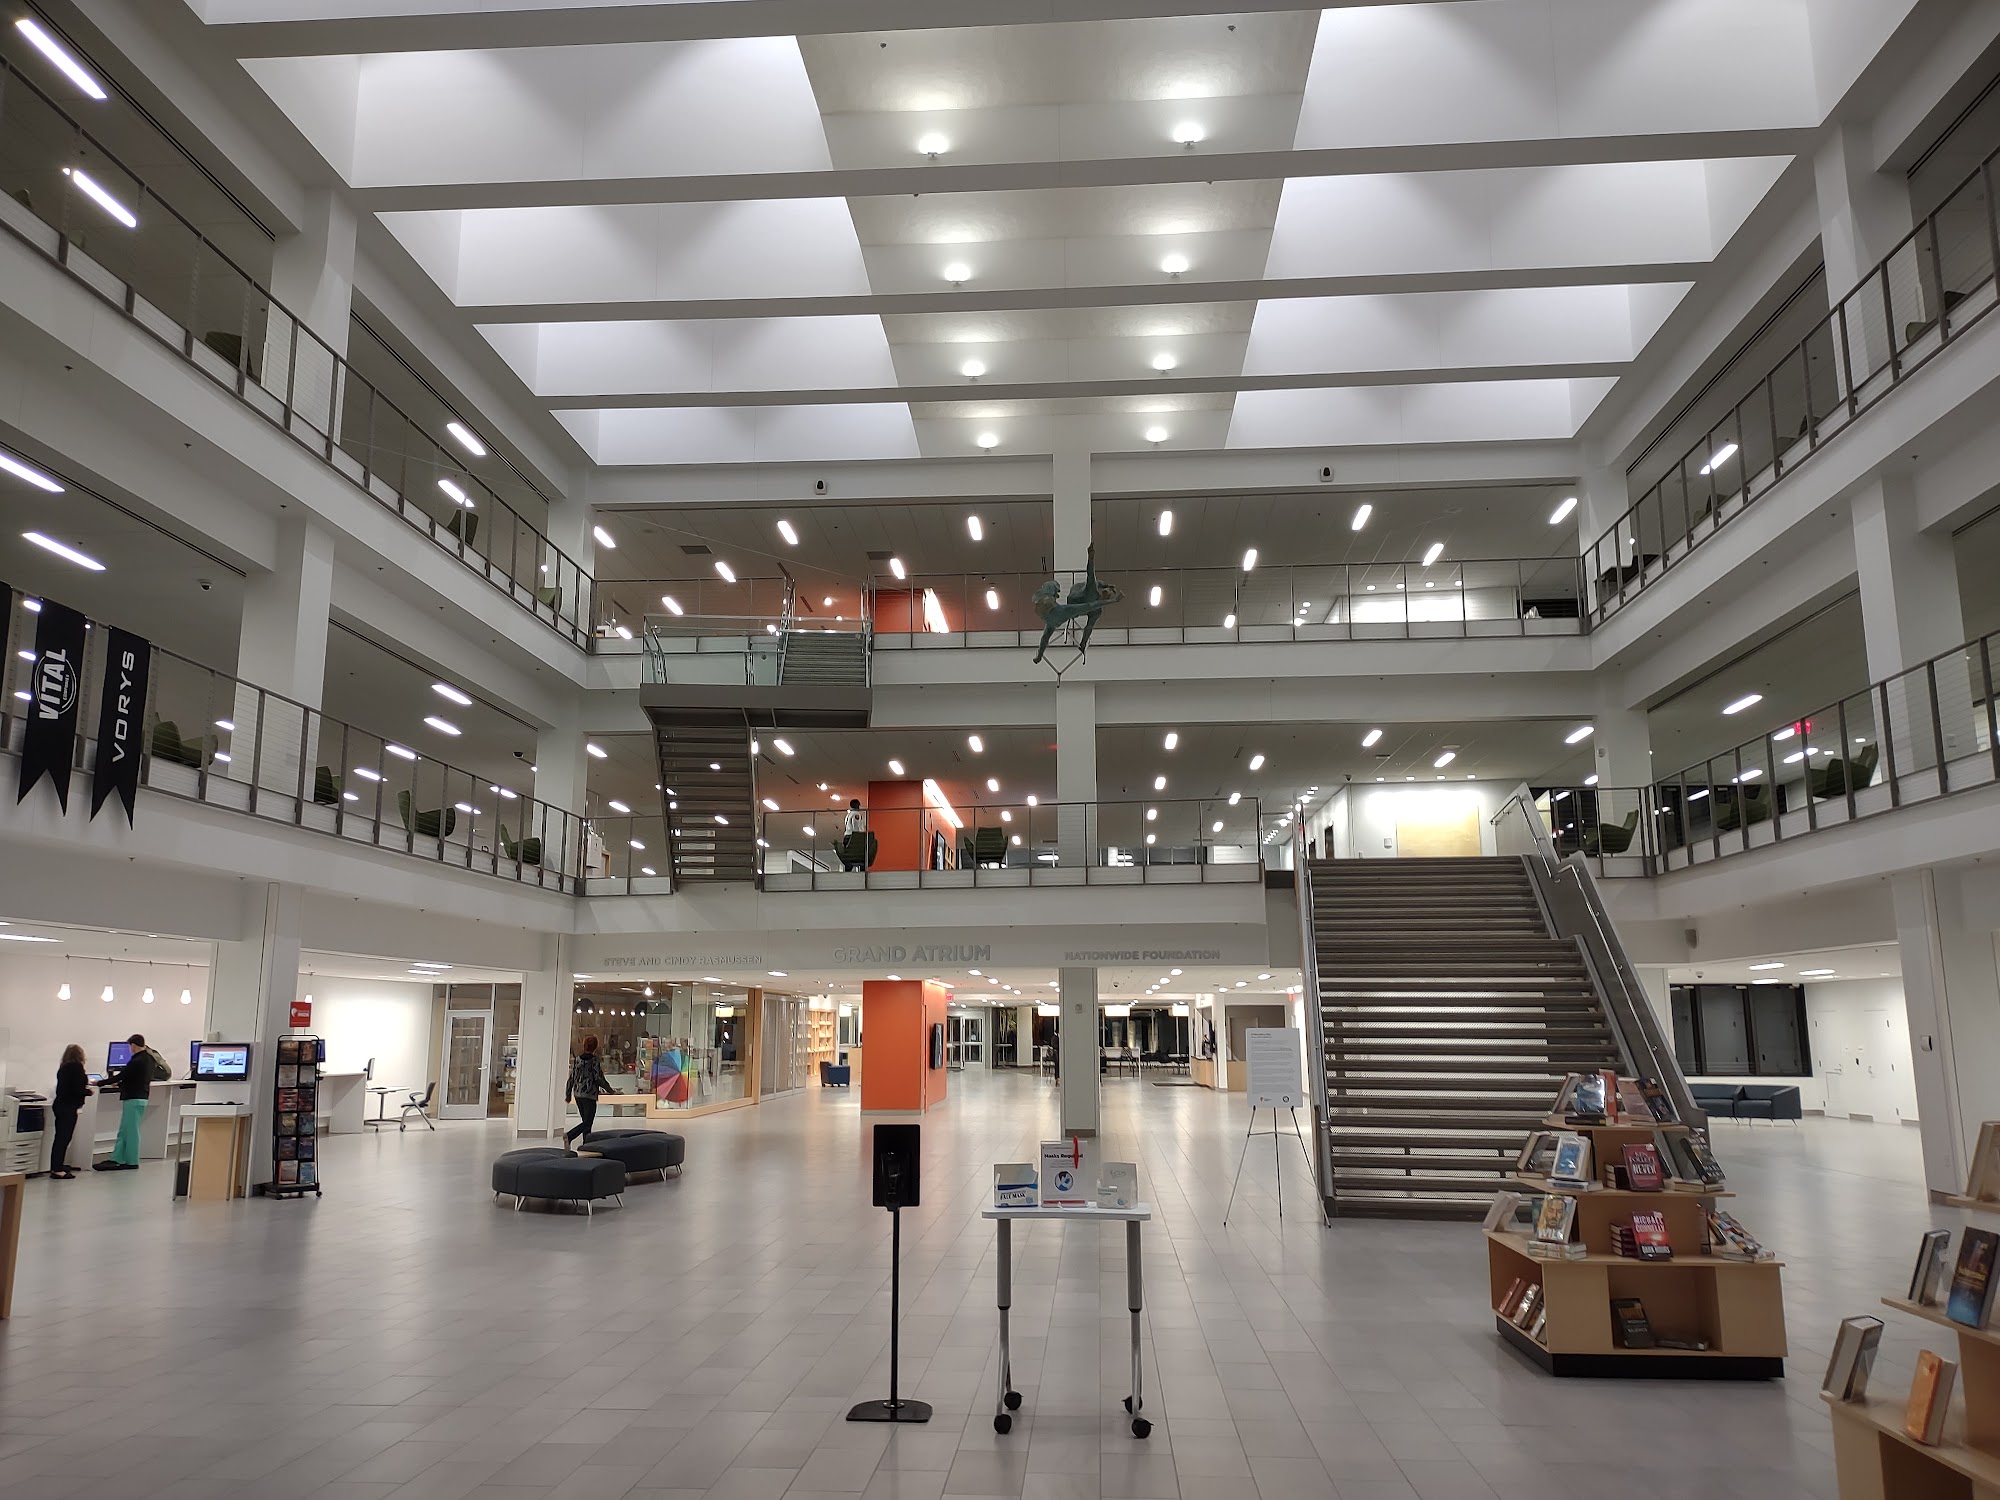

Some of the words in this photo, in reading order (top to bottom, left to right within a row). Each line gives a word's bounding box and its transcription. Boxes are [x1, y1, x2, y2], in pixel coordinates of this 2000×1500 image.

[39, 648, 66, 720] VITAL
[112, 650, 135, 763] VORYS
[604, 957, 636, 967] STEVE
[638, 957, 661, 966] AND
[664, 956, 697, 966] CINDY
[699, 955, 763, 965] RASMUSSEN
[833, 945, 907, 963] GRAND
[911, 944, 991, 962] ATRIUM
[1064, 950, 1140, 961] NATIONWIDE
[1142, 949, 1221, 960] FOUNDATION
